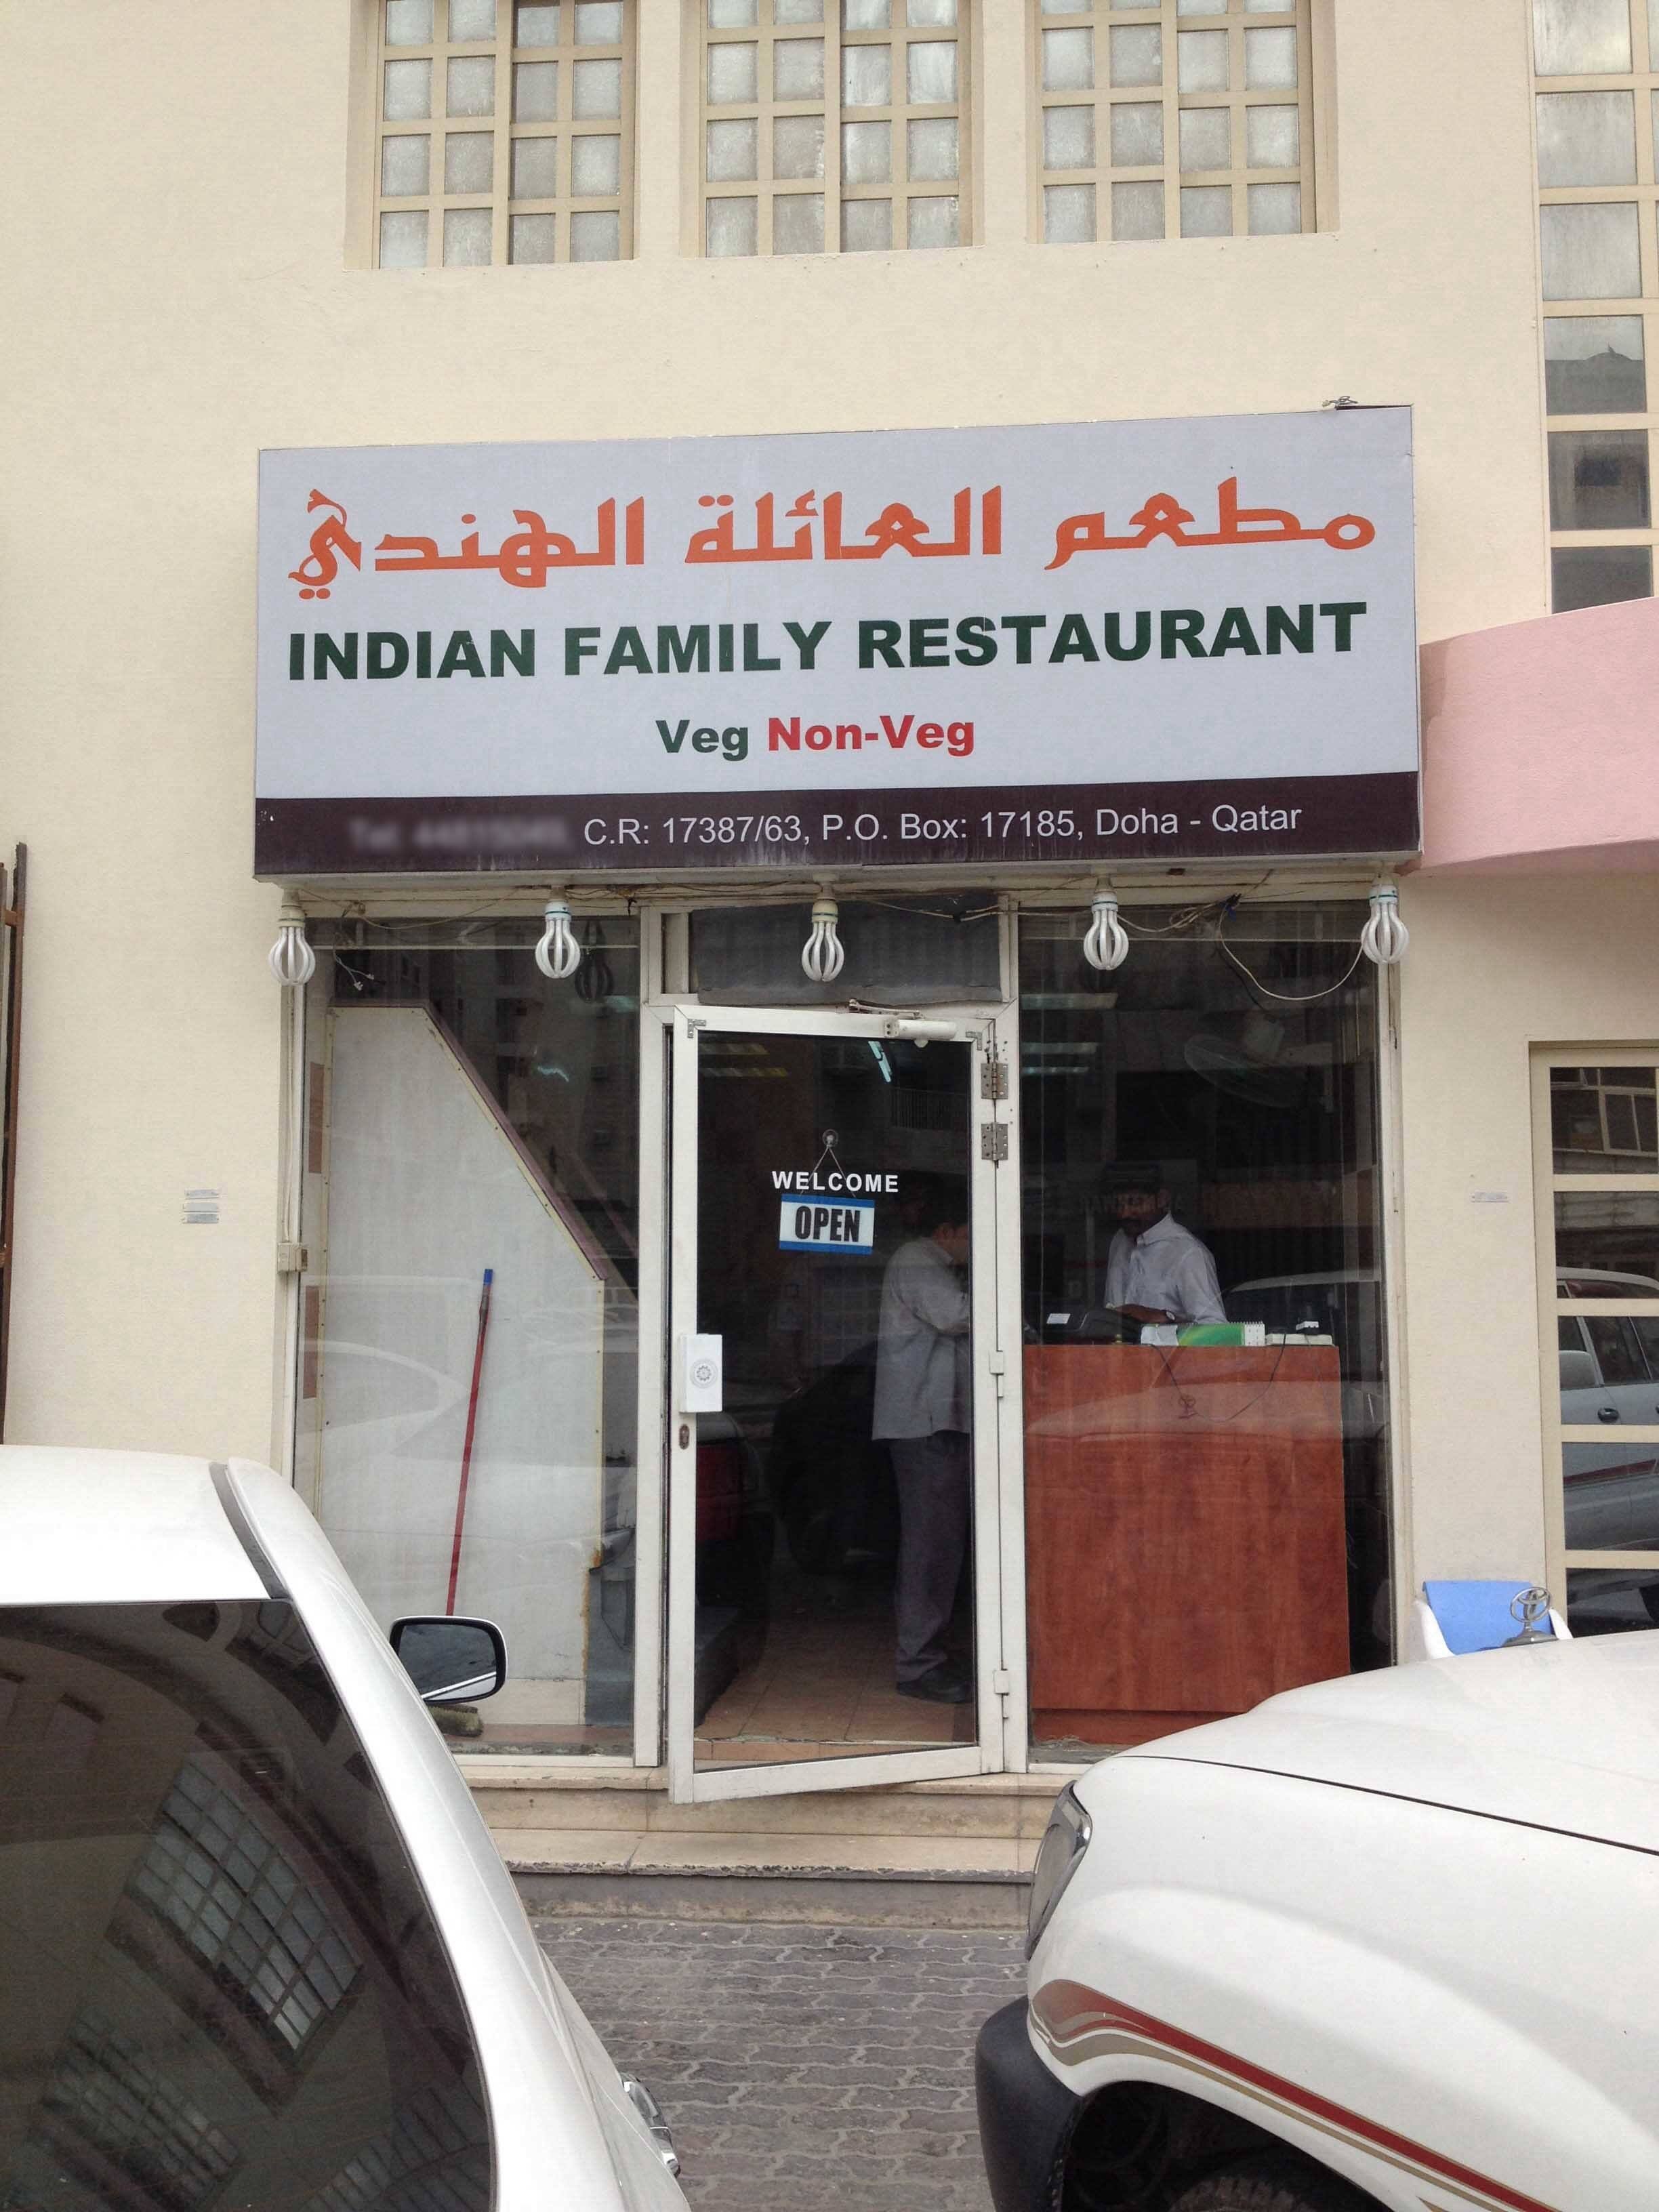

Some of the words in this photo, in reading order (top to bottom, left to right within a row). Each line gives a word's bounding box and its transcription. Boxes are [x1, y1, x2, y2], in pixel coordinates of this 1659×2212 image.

[288, 489, 644, 600] الهندي
[684, 485, 1002, 565] العائلة
[1045, 476, 1376, 571] مطعم
[289, 628, 535, 680] INDIAN
[565, 621, 832, 676] FAMILY
[859, 601, 1367, 669] RESTAURANT
[655, 719, 748, 762] Veg
[769, 715, 974, 757] Non-Veg
[584, 818, 649, 845] C.R:
[663, 815, 809, 845] 17387/63,
[823, 813, 888, 840] P.O.
[901, 813, 966, 840] Box:
[981, 810, 1083, 840] 17185,
[1097, 808, 1178, 836] Doha
[1212, 804, 1303, 833] Qatar
[771, 1170, 899, 1193] WELCOME
[794, 1204, 861, 1243] OPEN
